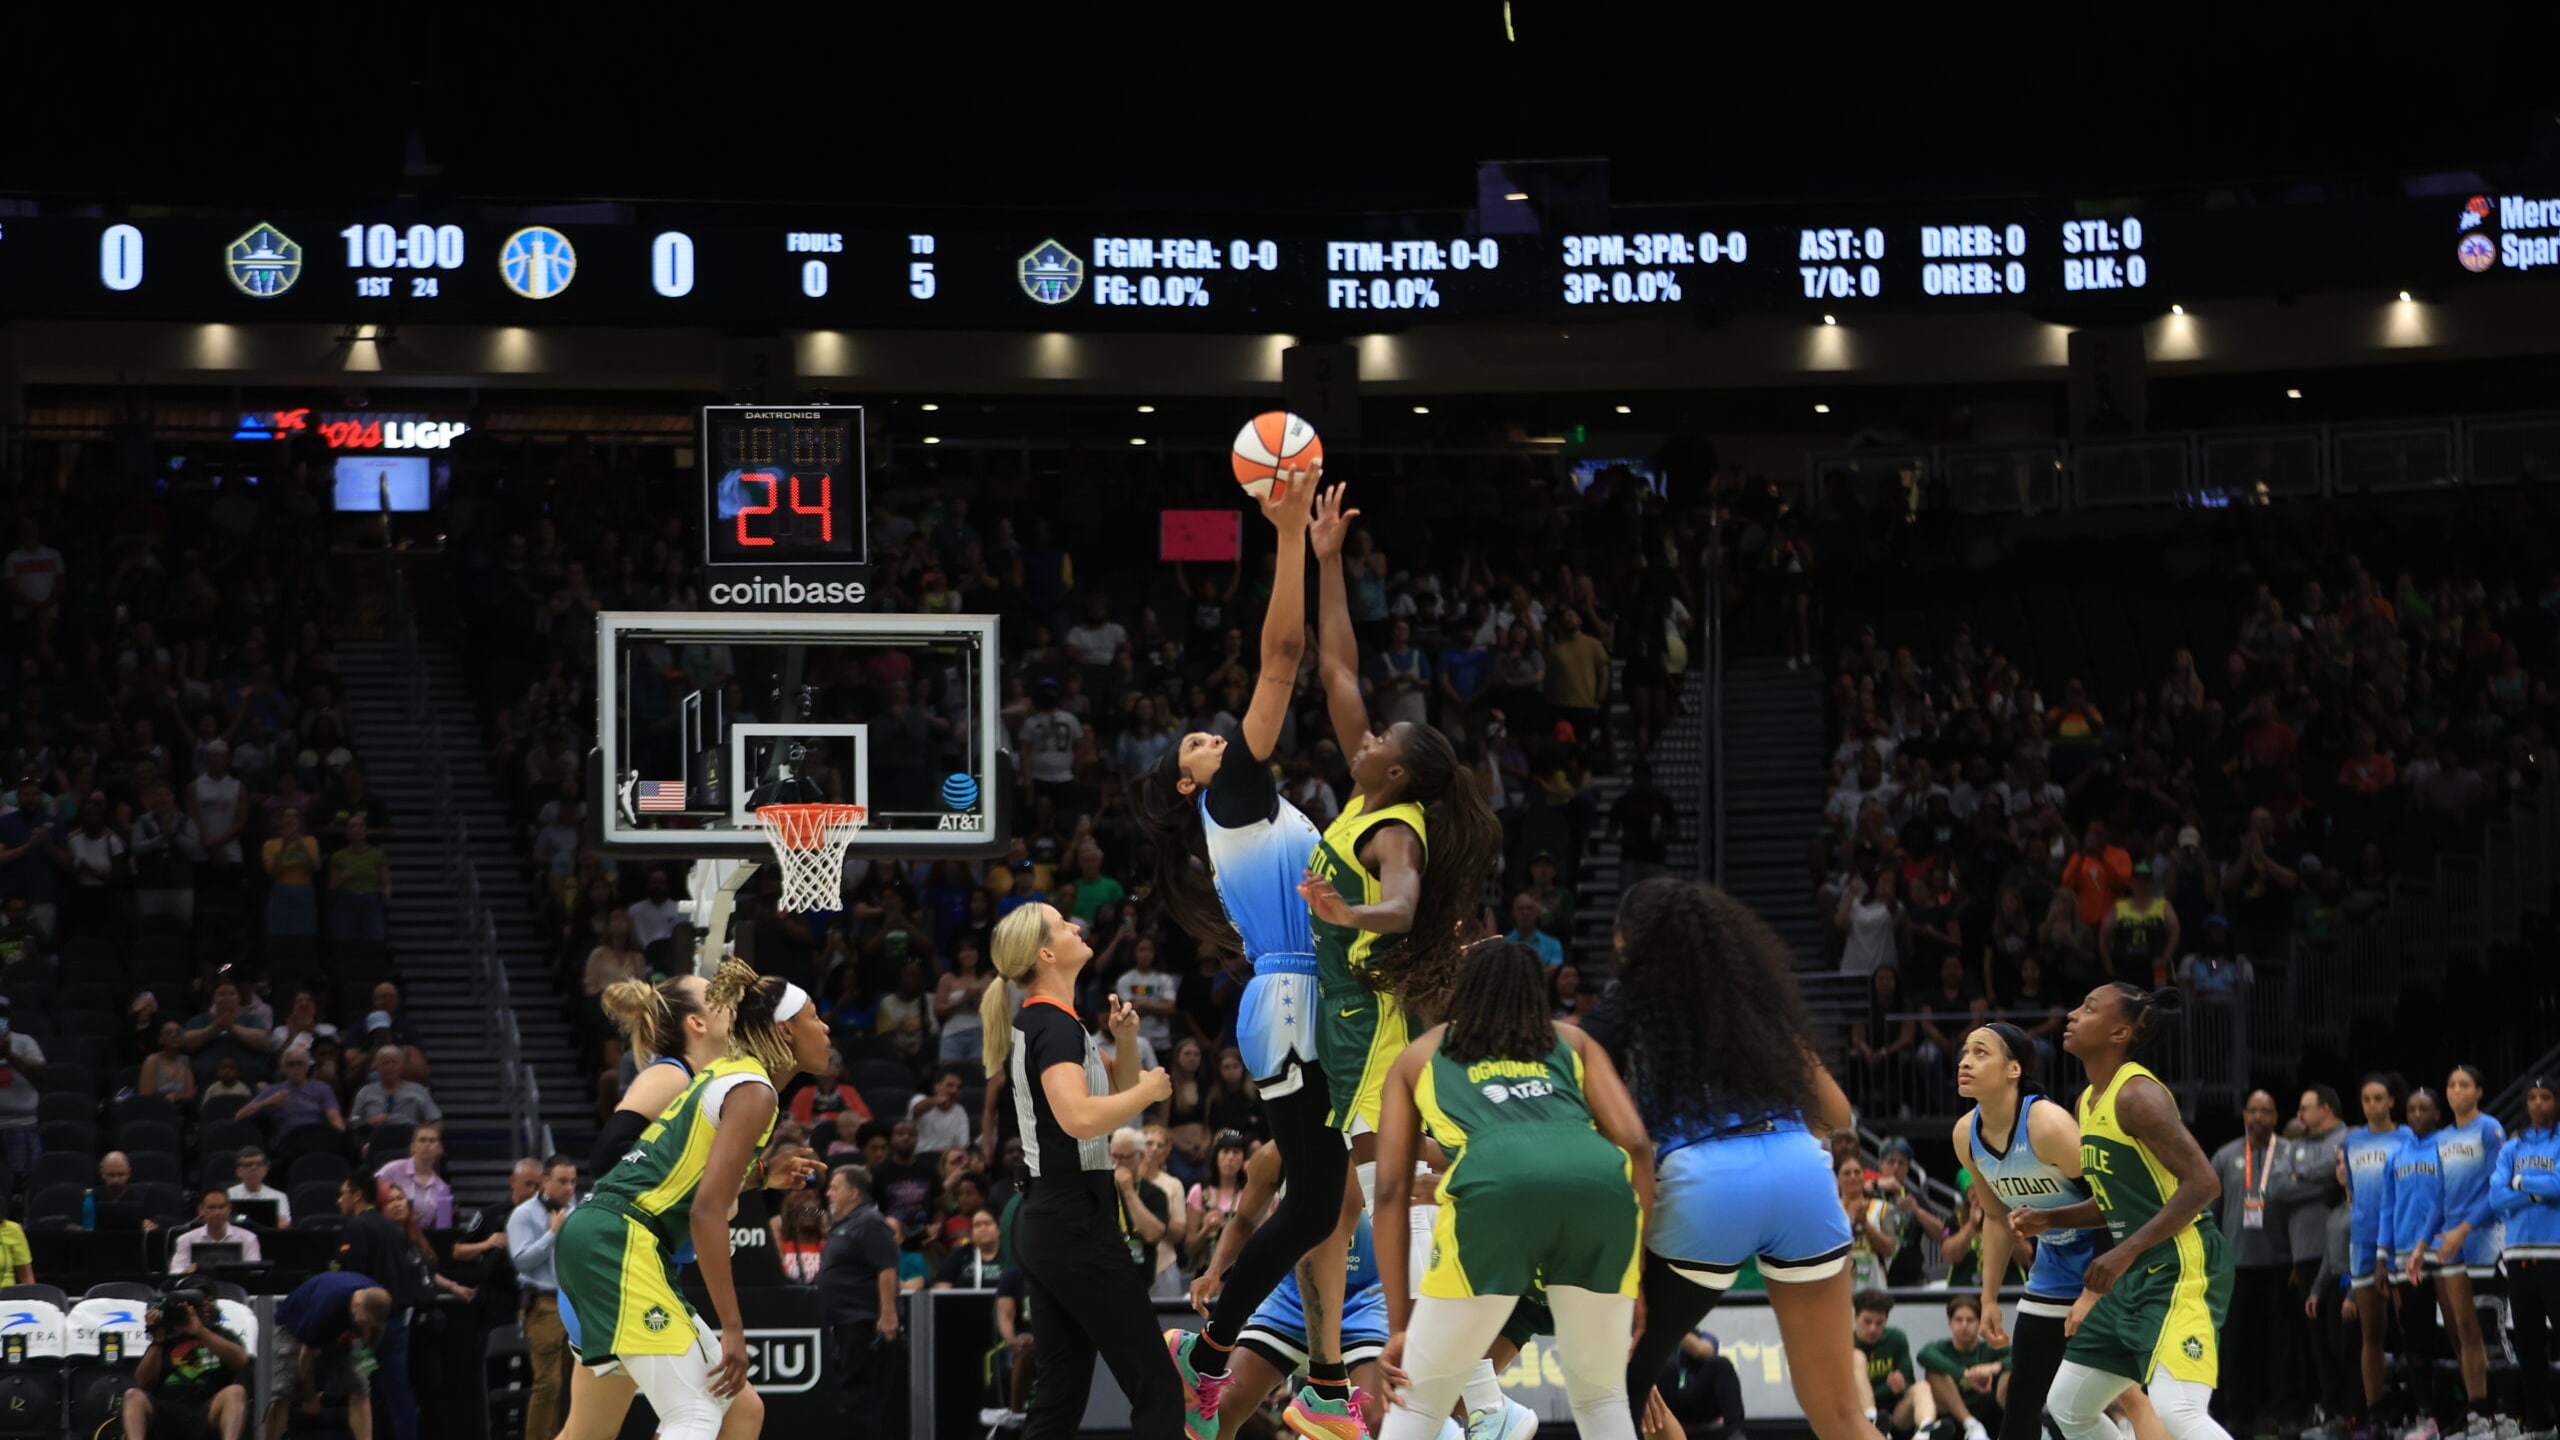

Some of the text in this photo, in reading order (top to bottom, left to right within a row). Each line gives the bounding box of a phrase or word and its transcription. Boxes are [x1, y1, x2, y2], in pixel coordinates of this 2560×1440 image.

[100, 223, 144, 291] 0
[340, 223, 465, 270] 10:00
[786, 232, 843, 253] FOULS
[908, 234, 935, 255] TO
[1093, 237, 1278, 271] FGM-FGA: 0-0
[651, 231, 695, 298] 0
[802, 259, 828, 298] 0
[909, 261, 936, 300] 5
[356, 276, 439, 298] 1ST 24
[736, 473, 832, 546] 24
[710, 575, 866, 605] coinbase
[938, 814, 983, 831] AT&T
